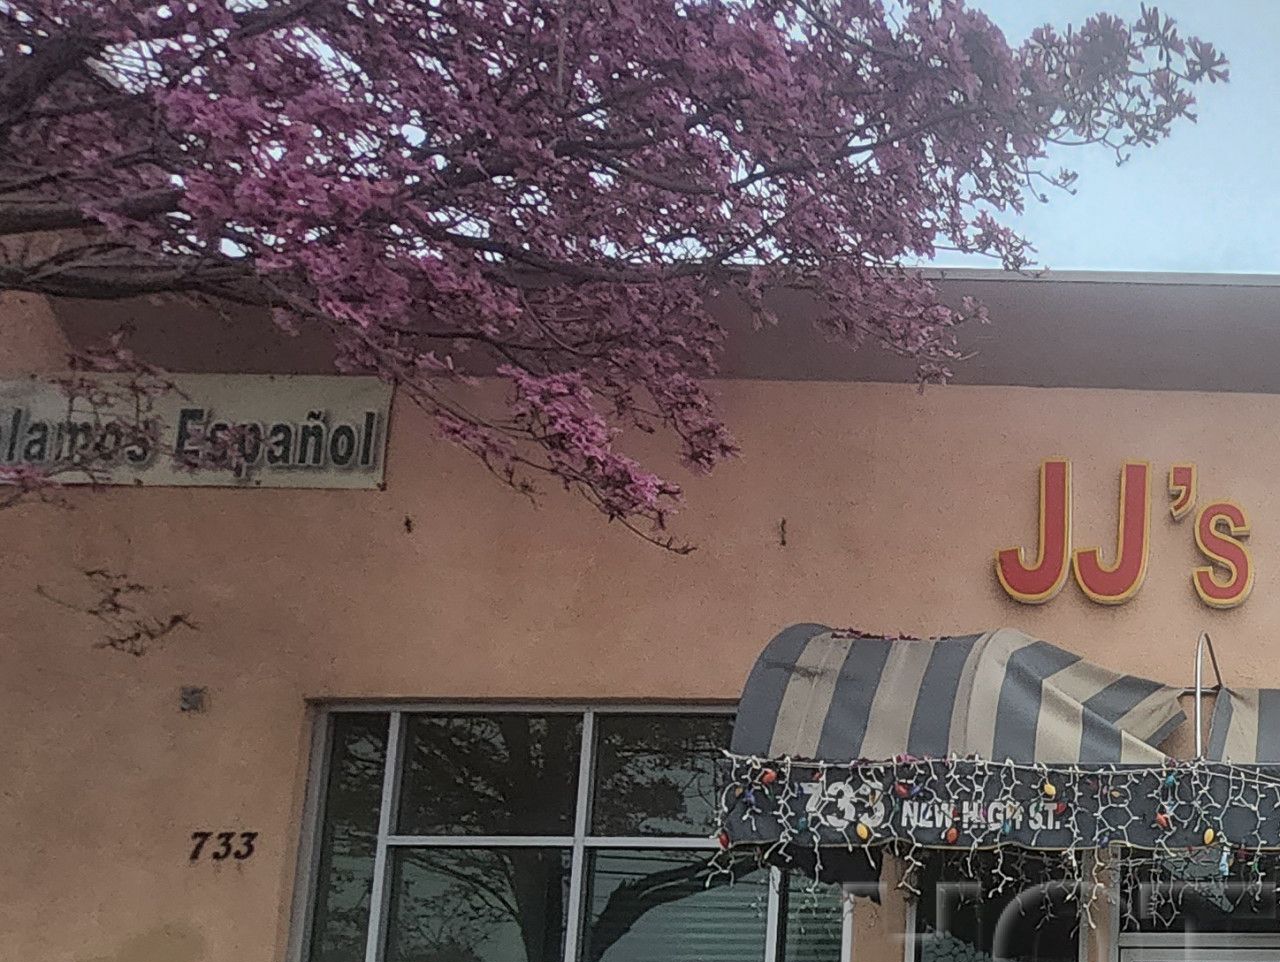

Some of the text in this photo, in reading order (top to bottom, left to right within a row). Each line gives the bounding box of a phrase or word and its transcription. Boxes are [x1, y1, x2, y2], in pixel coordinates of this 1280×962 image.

[0, 408, 377, 477] lamos Español
[996, 457, 1253, 608] JJ's
[799, 781, 885, 828] 733
[901, 802, 953, 828] NEW
[1029, 801, 1061, 829] ST.
[189, 831, 259, 861] 733
